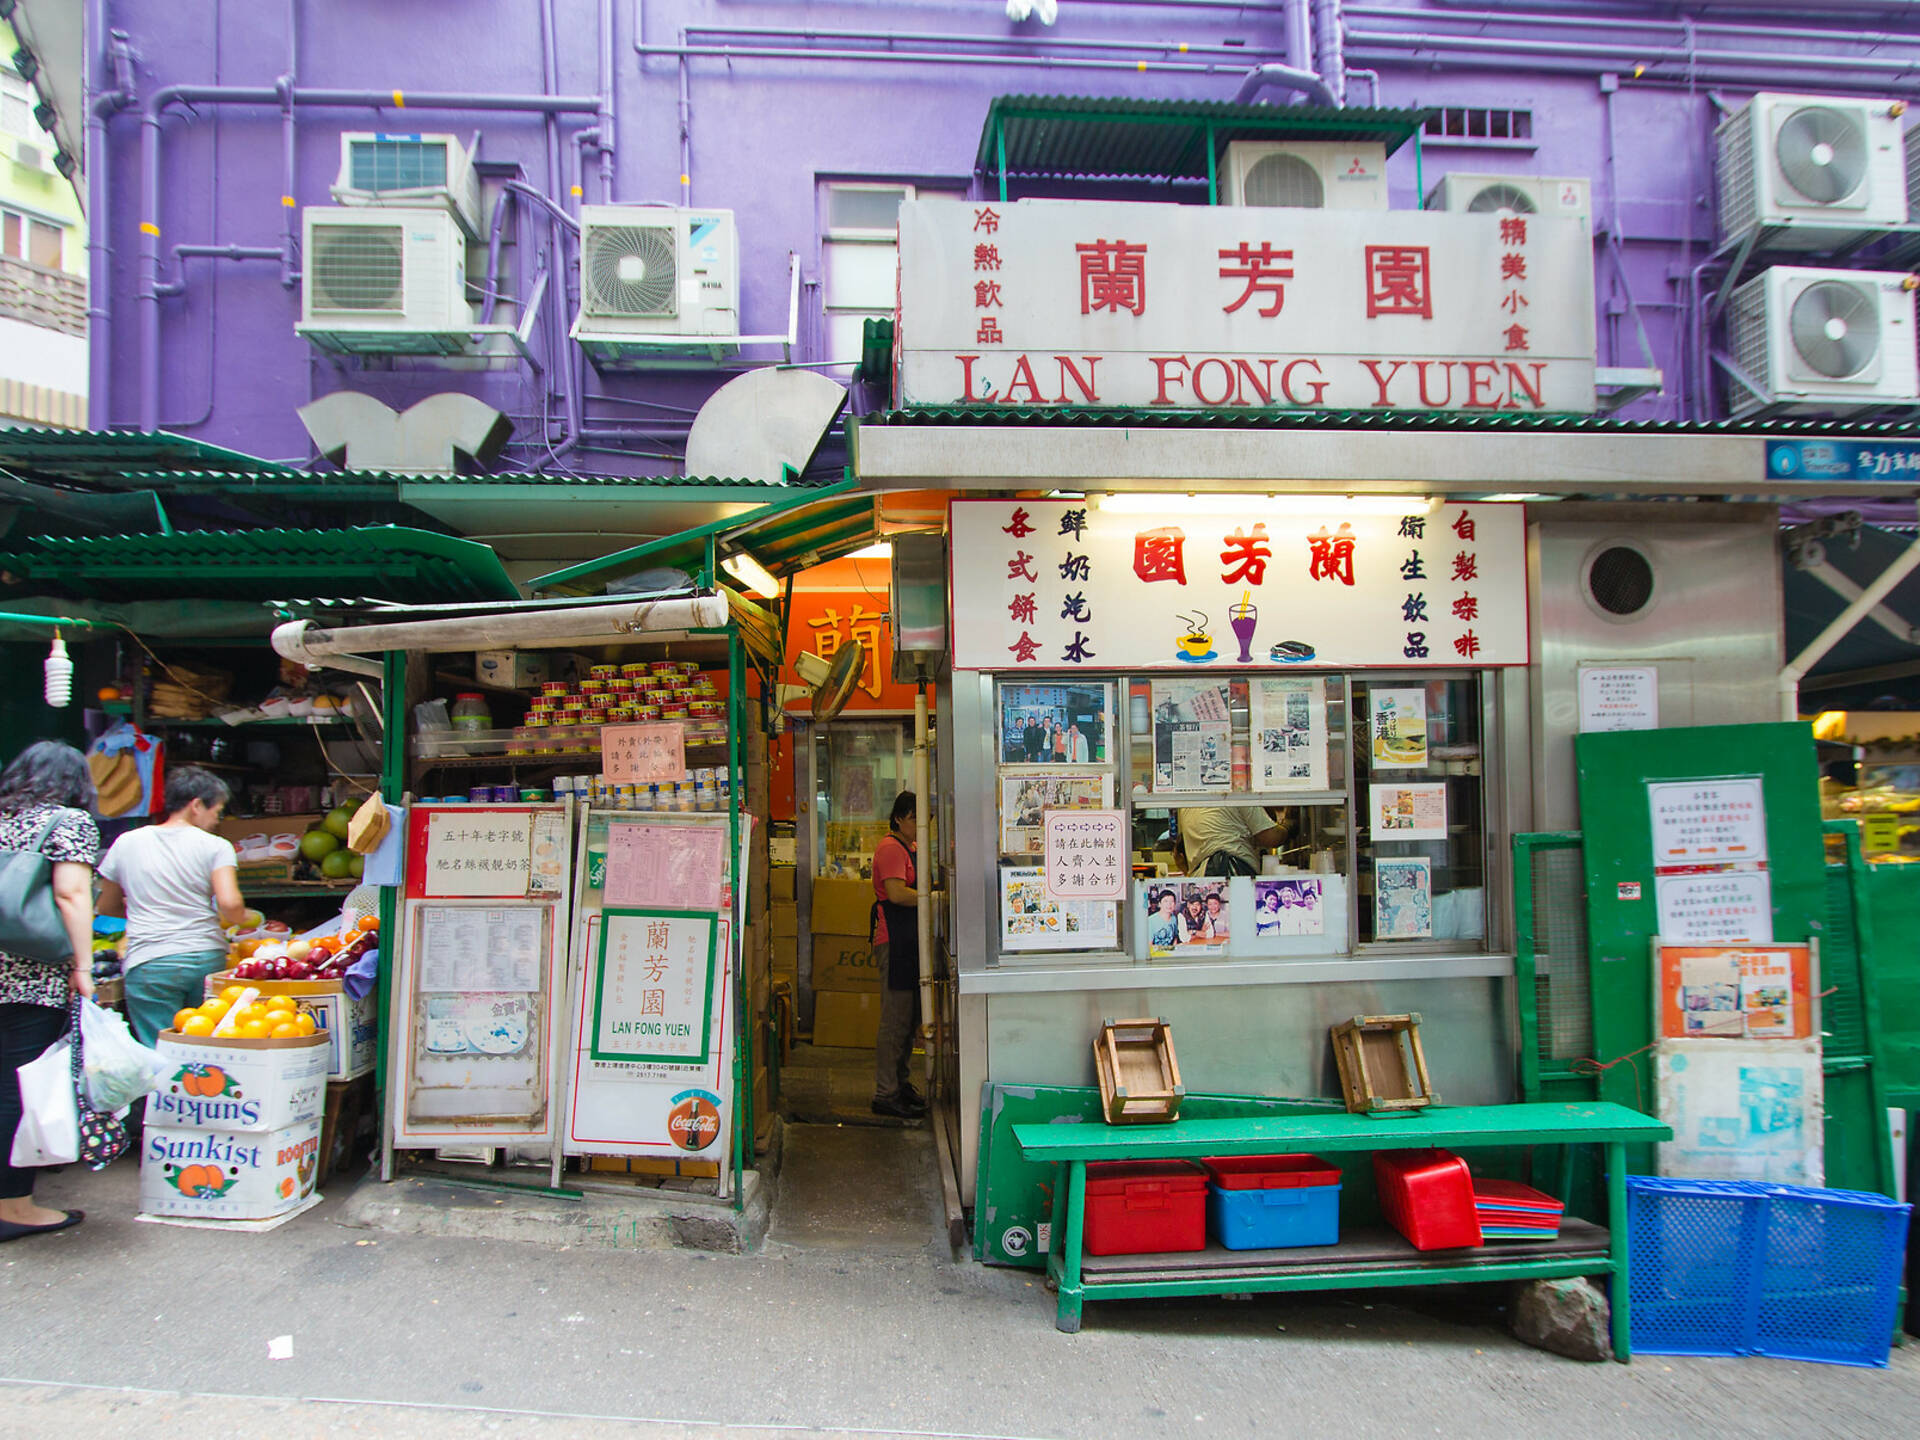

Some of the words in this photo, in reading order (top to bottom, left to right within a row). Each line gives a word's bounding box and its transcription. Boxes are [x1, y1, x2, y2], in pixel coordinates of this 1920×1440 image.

[973, 207, 1004, 344] 冷熱飲品
[1075, 238, 1433, 321] 蘭芳園
[1500, 217, 1531, 352] 精美小食
[955, 354, 1104, 406] LAN
[1148, 354, 1331, 406] FONG
[1359, 360, 1549, 411] YUEN
[1002, 506, 1043, 663] 各式餅食
[1057, 508, 1097, 663] 鮮奶汽水
[443, 829, 525, 843] 五十年老字號
[1055, 838, 1116, 850] 請在此輪候
[1056, 854, 1116, 867] 人齊入坐
[1057, 873, 1117, 887] 多謝合作
[640, 921, 670, 1017] 蘭芳園
[612, 1021, 631, 1034] LAN
[635, 1022, 661, 1036] FONG
[665, 1023, 691, 1037] YUEN
[153, 1090, 261, 1126] Sunkist
[149, 1134, 261, 1168] Sunkist
